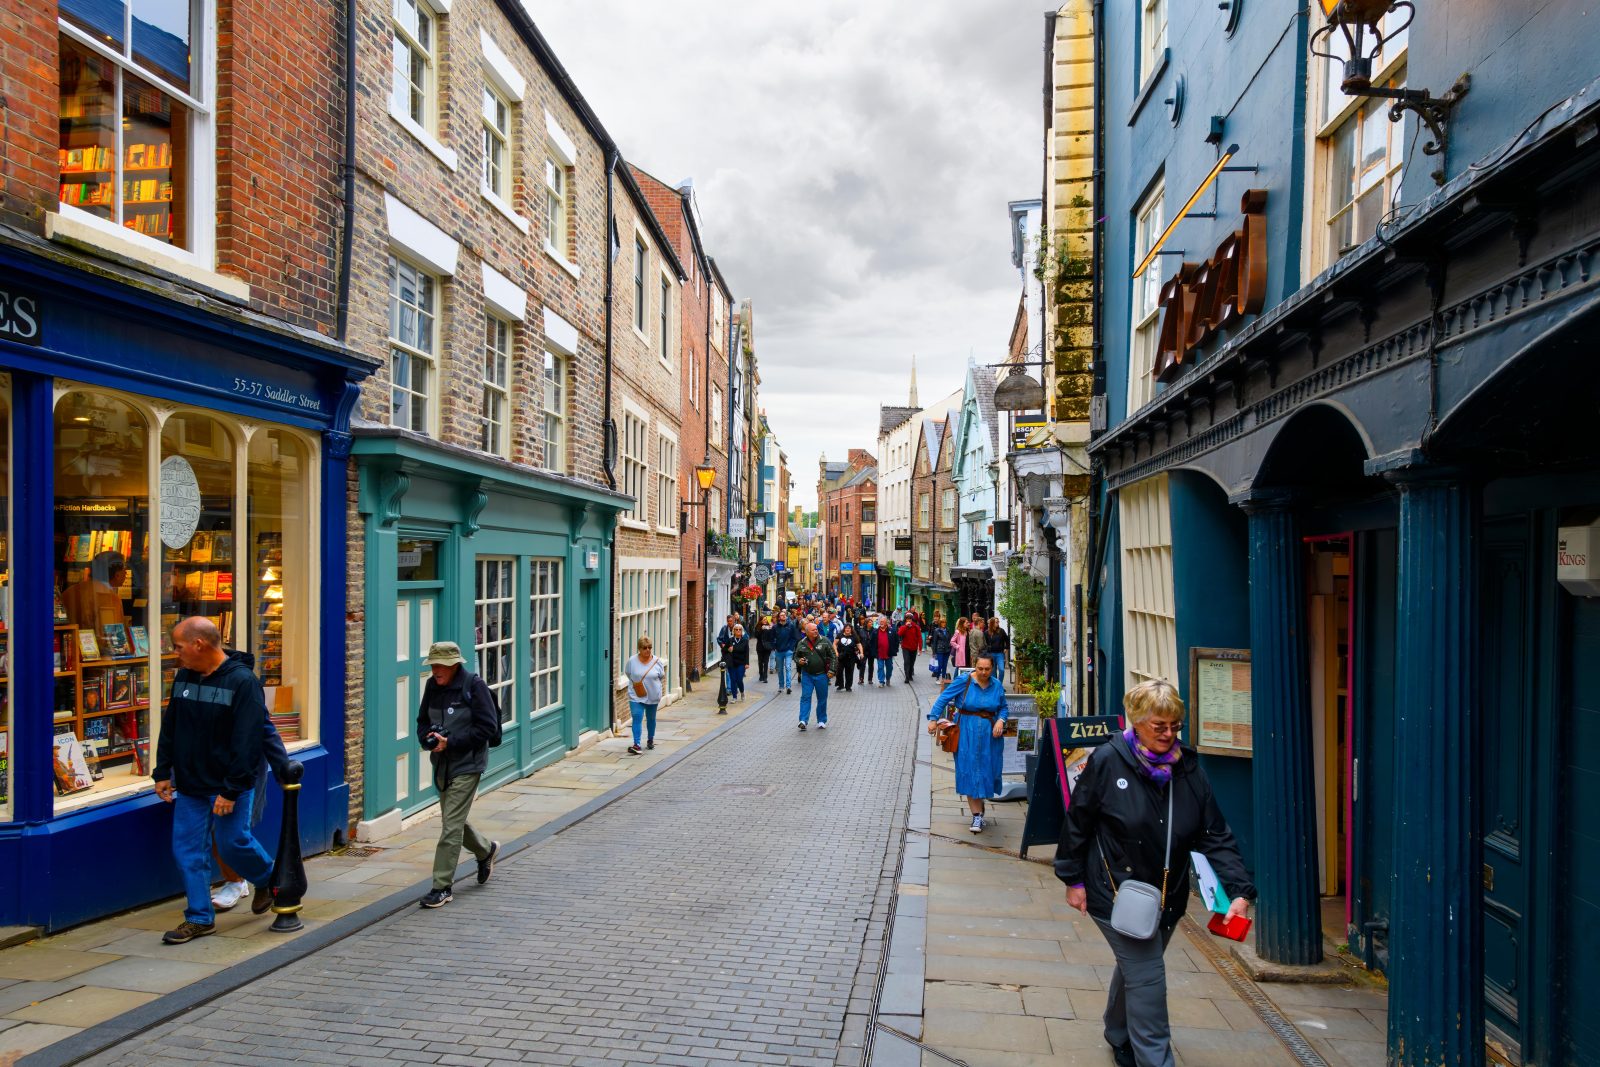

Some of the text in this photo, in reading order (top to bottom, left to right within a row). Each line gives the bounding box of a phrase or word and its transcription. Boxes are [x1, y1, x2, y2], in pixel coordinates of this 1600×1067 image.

[232, 377, 321, 410] 55-57 Saddler Street
[82, 504, 116, 512] Hardbacks
[1558, 551, 1586, 566] KINGS
[1070, 722, 1109, 739] Zizzi
[58, 736, 75, 745] ICON
